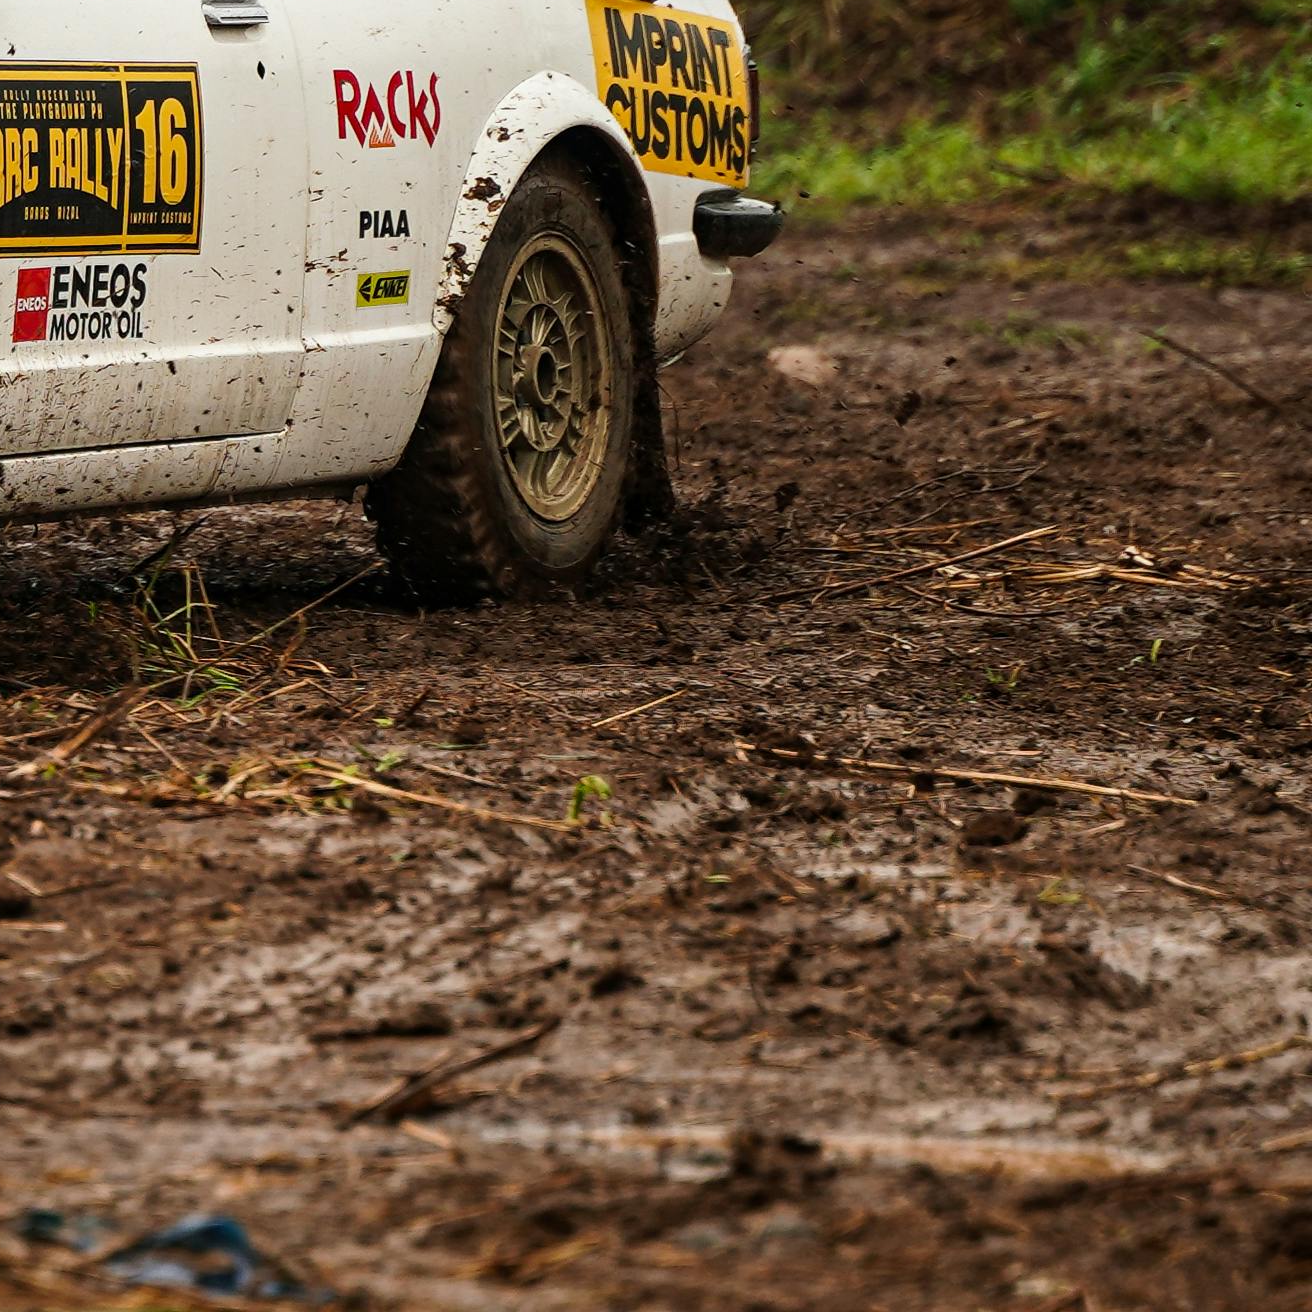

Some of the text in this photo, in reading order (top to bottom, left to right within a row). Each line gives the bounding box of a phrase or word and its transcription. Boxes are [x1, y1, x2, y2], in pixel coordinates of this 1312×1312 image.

[604, 7, 732, 99] IMPRINT
[0, 102, 18, 120] THE
[22, 102, 86, 120] PLAYGROUND
[605, 83, 746, 174] CUSTOMS
[49, 127, 124, 210] RALLY
[135, 98, 188, 206] 16
[359, 210, 410, 238] PIAA
[17, 296, 47, 312] ENEOS
[52, 263, 148, 308] ENEOS
[372, 276, 409, 299] ENKEI
[49, 310, 144, 341] MOTOR OIL
